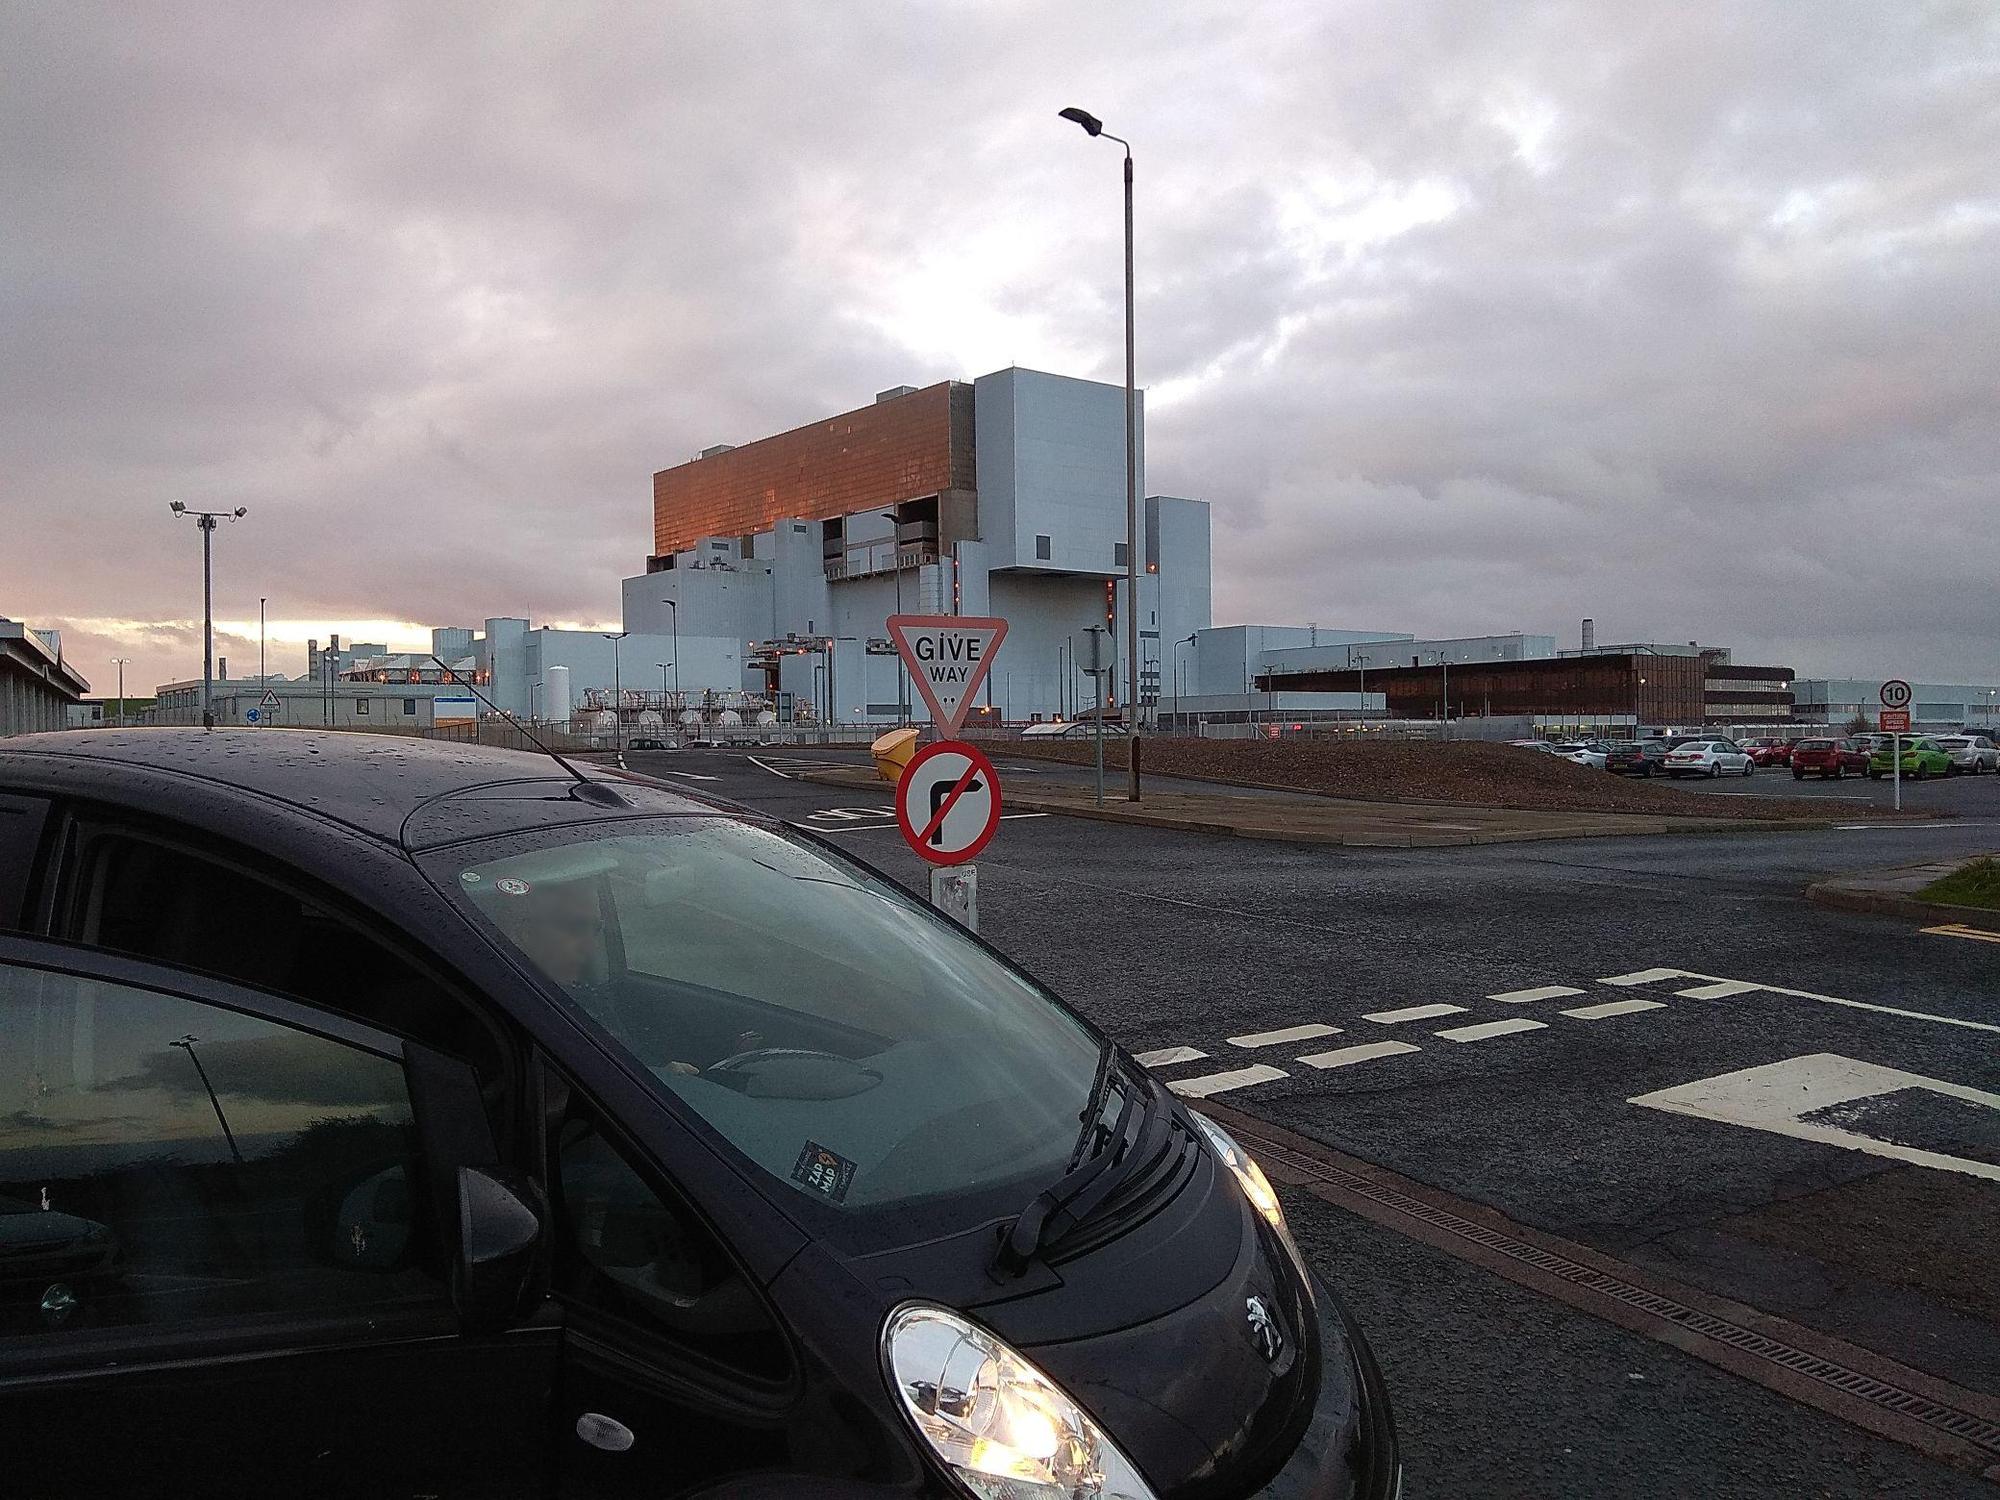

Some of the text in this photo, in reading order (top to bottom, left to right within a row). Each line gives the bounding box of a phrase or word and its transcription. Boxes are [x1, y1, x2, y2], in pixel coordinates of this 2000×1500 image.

[915, 636, 981, 661] GIVE
[929, 666, 969, 683] WAY
[1886, 687, 1905, 701] 10
[808, 1163, 824, 1186] ZAP
[820, 1168, 836, 1193] MAP
